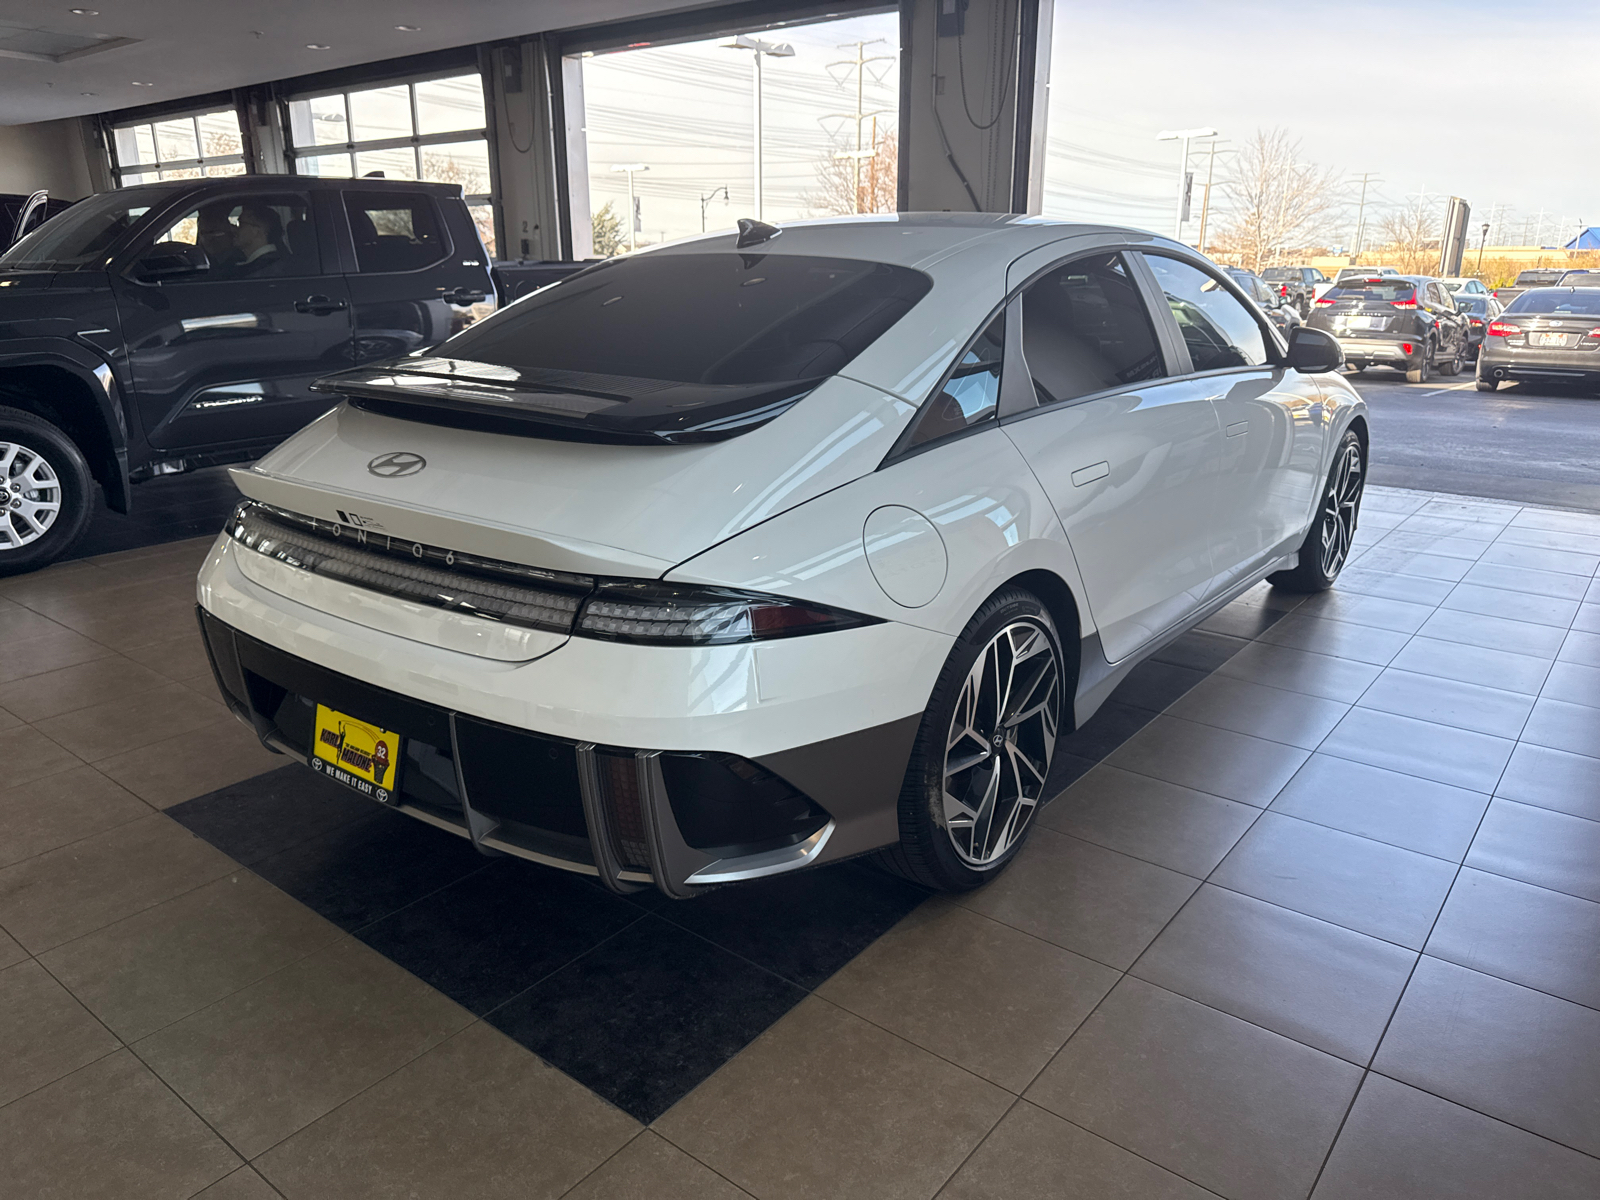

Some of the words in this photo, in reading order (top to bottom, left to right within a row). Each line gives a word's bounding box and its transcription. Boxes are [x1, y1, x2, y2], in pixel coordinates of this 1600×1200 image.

[522, 221, 529, 233] 2
[312, 517, 422, 558] IONIQ
[445, 551, 454, 565] 6
[320, 728, 339, 748] KARL
[341, 747, 372, 773] MALONE
[377, 746, 386, 759] 32
[326, 765, 335, 776] WE
[336, 769, 350, 784] MAKE
[351, 779, 357, 787] IT
[358, 780, 372, 794] EASY
